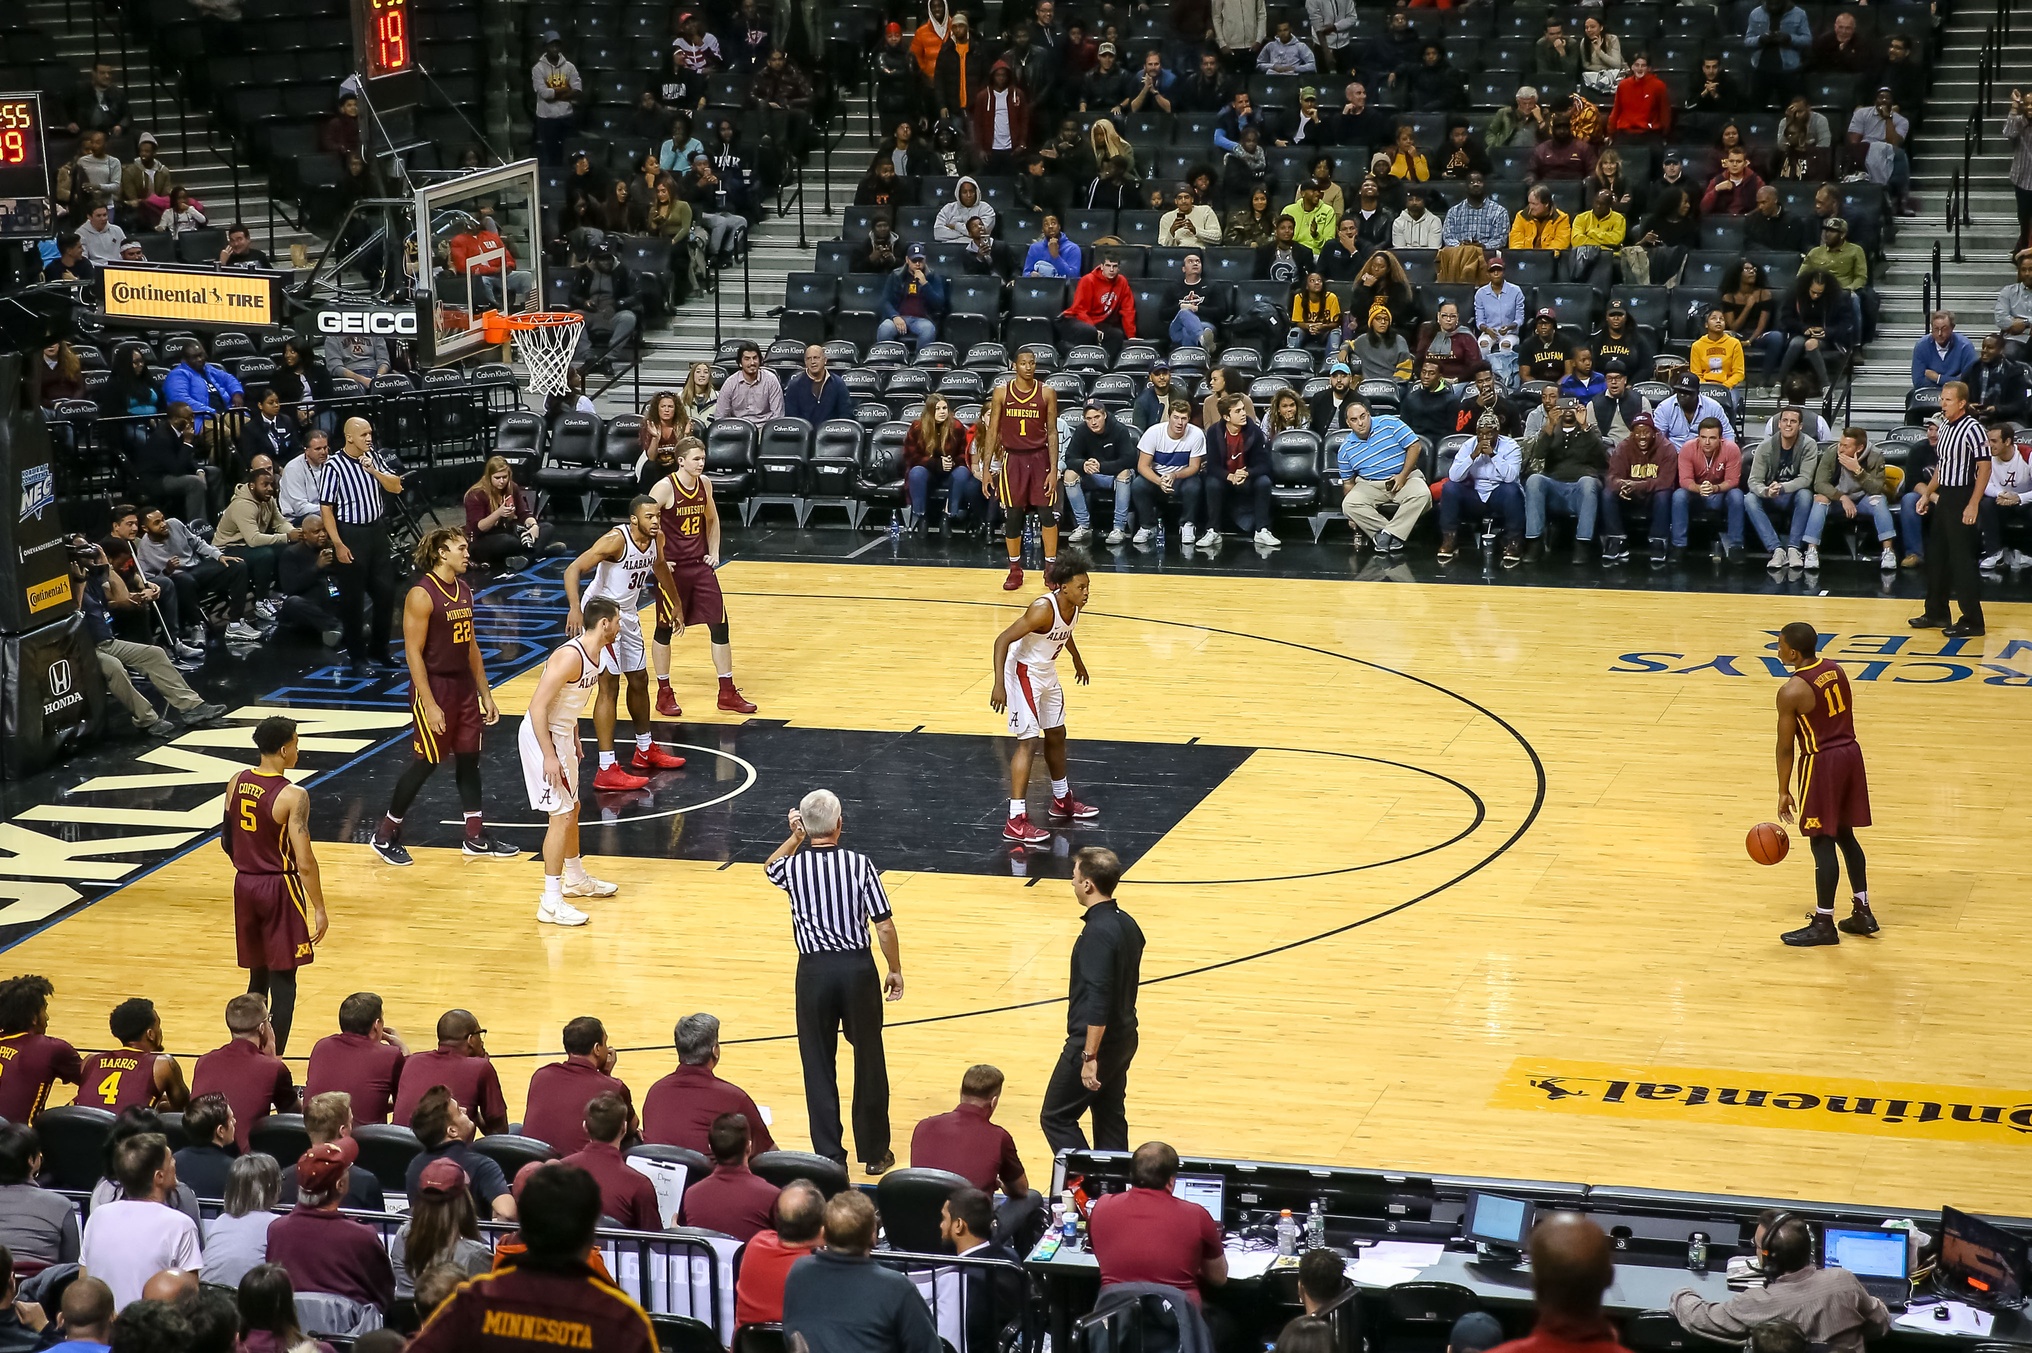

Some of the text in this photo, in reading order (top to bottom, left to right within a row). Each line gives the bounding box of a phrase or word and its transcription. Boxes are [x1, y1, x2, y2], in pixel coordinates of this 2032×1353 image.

[380, 11, 404, 67] 19
[0, 132, 23, 163] 9
[112, 282, 264, 308] Continental TIRE
[317, 311, 417, 335] GEICO
[215, 338, 250, 347] Calvin Klein
[264, 335, 282, 343] Calvin
[771, 346, 789, 354] Calvin
[840, 347, 854, 355] Klein
[938, 349, 953, 357] Klein
[968, 348, 1003, 357] Calvin Klein
[1038, 350, 1053, 359] Klein
[1070, 352, 1105, 360] Calvin Klein
[1121, 352, 1139, 360] Calvin
[1170, 354, 1206, 362] Calvin Klein
[1222, 354, 1241, 362] Calvin
[1274, 355, 1310, 363] Calvin Klein
[1535, 351, 1564, 363] JELLYFAM
[240, 363, 275, 372] Calvin Klein
[425, 375, 443, 383] Calvin
[476, 370, 512, 379] Calvin Klein
[841, 375, 876, 383] Calvin Klein
[892, 375, 926, 383] Calvin Klein
[343, 383, 359, 391] Klein
[375, 379, 410, 389] Calvin Klein
[1252, 384, 1270, 392] Calvin
[1359, 385, 1395, 394] Calvin Klein
[1654, 387, 1670, 395] Klein
[1915, 393, 1936, 402] Calvin
[60, 405, 98, 415] Calvin Klein
[872, 409, 888, 417] Klein
[1006, 408, 1040, 419] MINNESOTA
[955, 411, 974, 419] Calvin
[1019, 419, 1027, 436] 1
[2000, 471, 2017, 488] A
[20, 475, 53, 516] NEC
[680, 516, 700, 536] 42
[628, 571, 646, 590] 30
[30, 583, 64, 607] Continental
[453, 621, 471, 644] 22
[1051, 643, 1063, 660] 2
[44, 692, 84, 715] HONDA
[1824, 688, 1846, 718] 11
[238, 782, 265, 798] COFFEY
[240, 799, 257, 832] 5
[0, 1046, 19, 1062] PHY
[100, 1057, 138, 1071] HARRIS
[98, 1071, 123, 1105] 4
[482, 1311, 594, 1350] MINNESOTA
